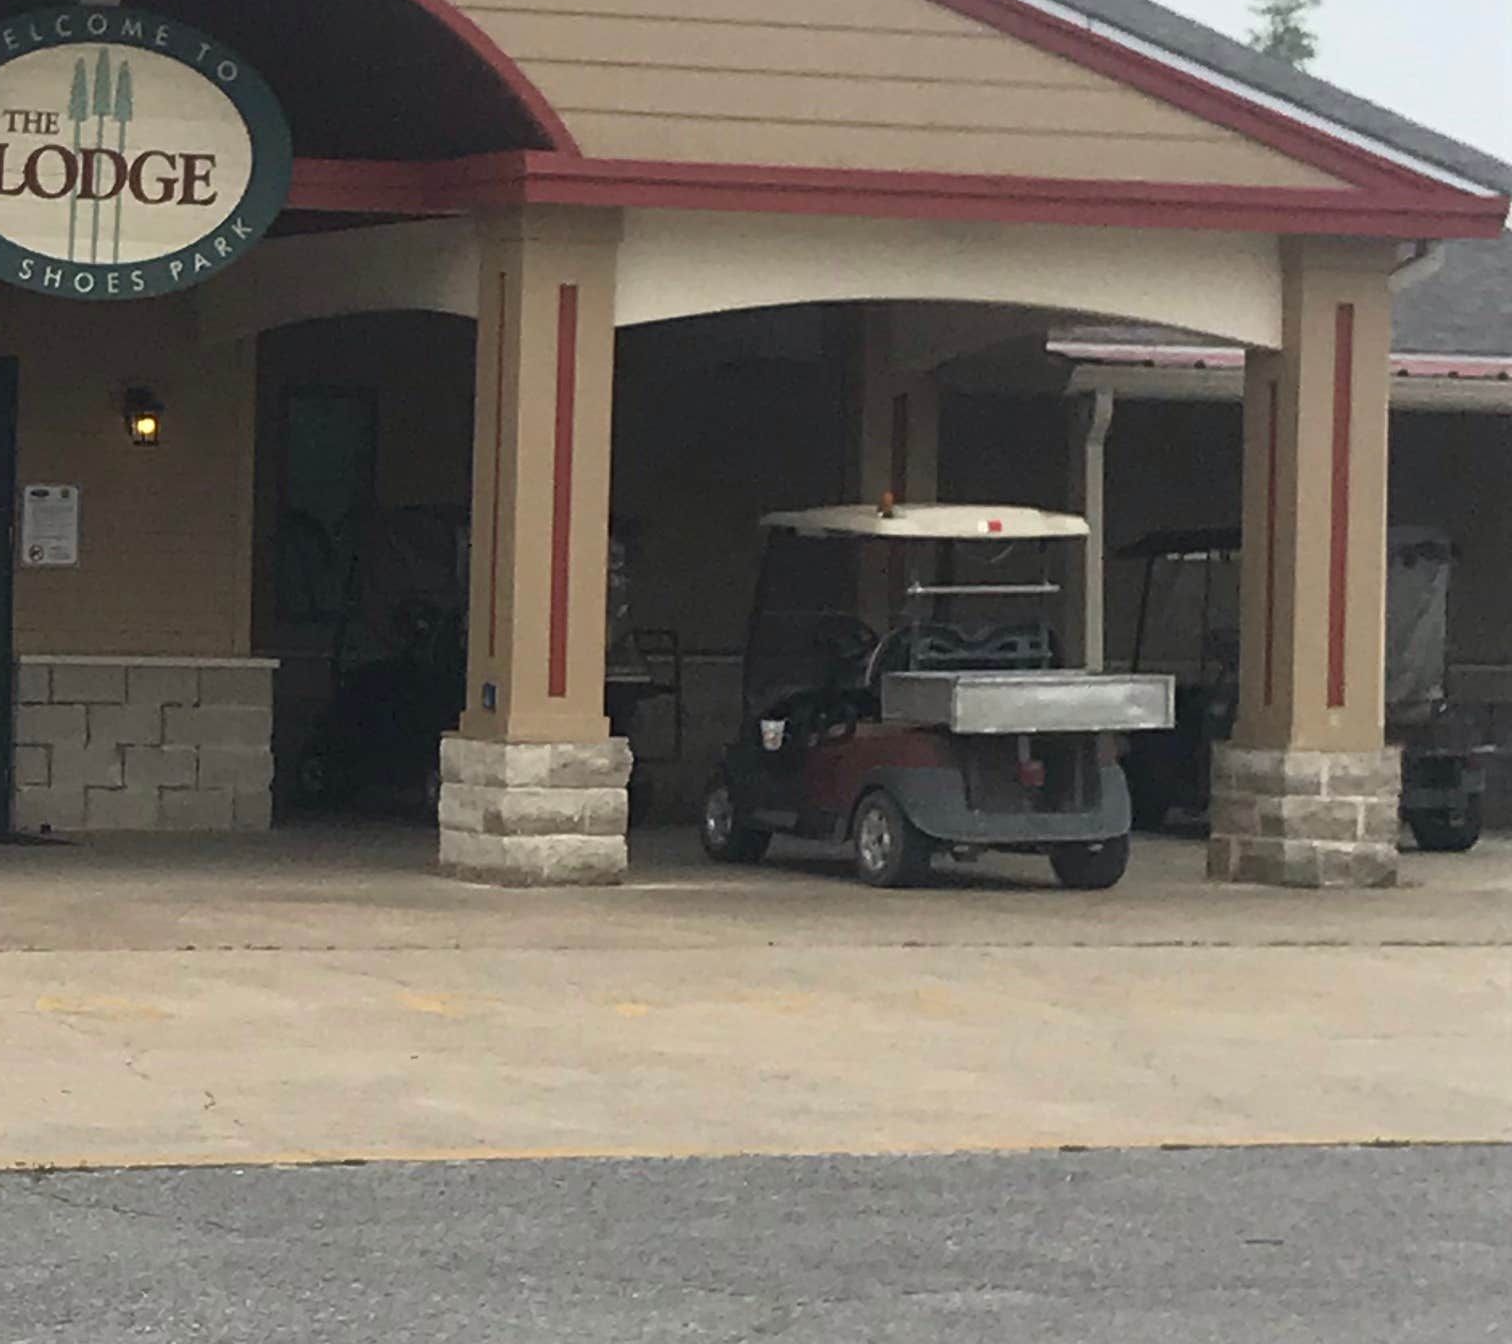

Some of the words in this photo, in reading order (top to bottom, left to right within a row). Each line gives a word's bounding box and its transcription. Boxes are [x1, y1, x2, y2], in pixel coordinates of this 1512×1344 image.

[198, 42, 238, 82] TO
[2, 109, 60, 135] THE
[18, 258, 145, 293] SHOES
[170, 217, 253, 281] PARK
